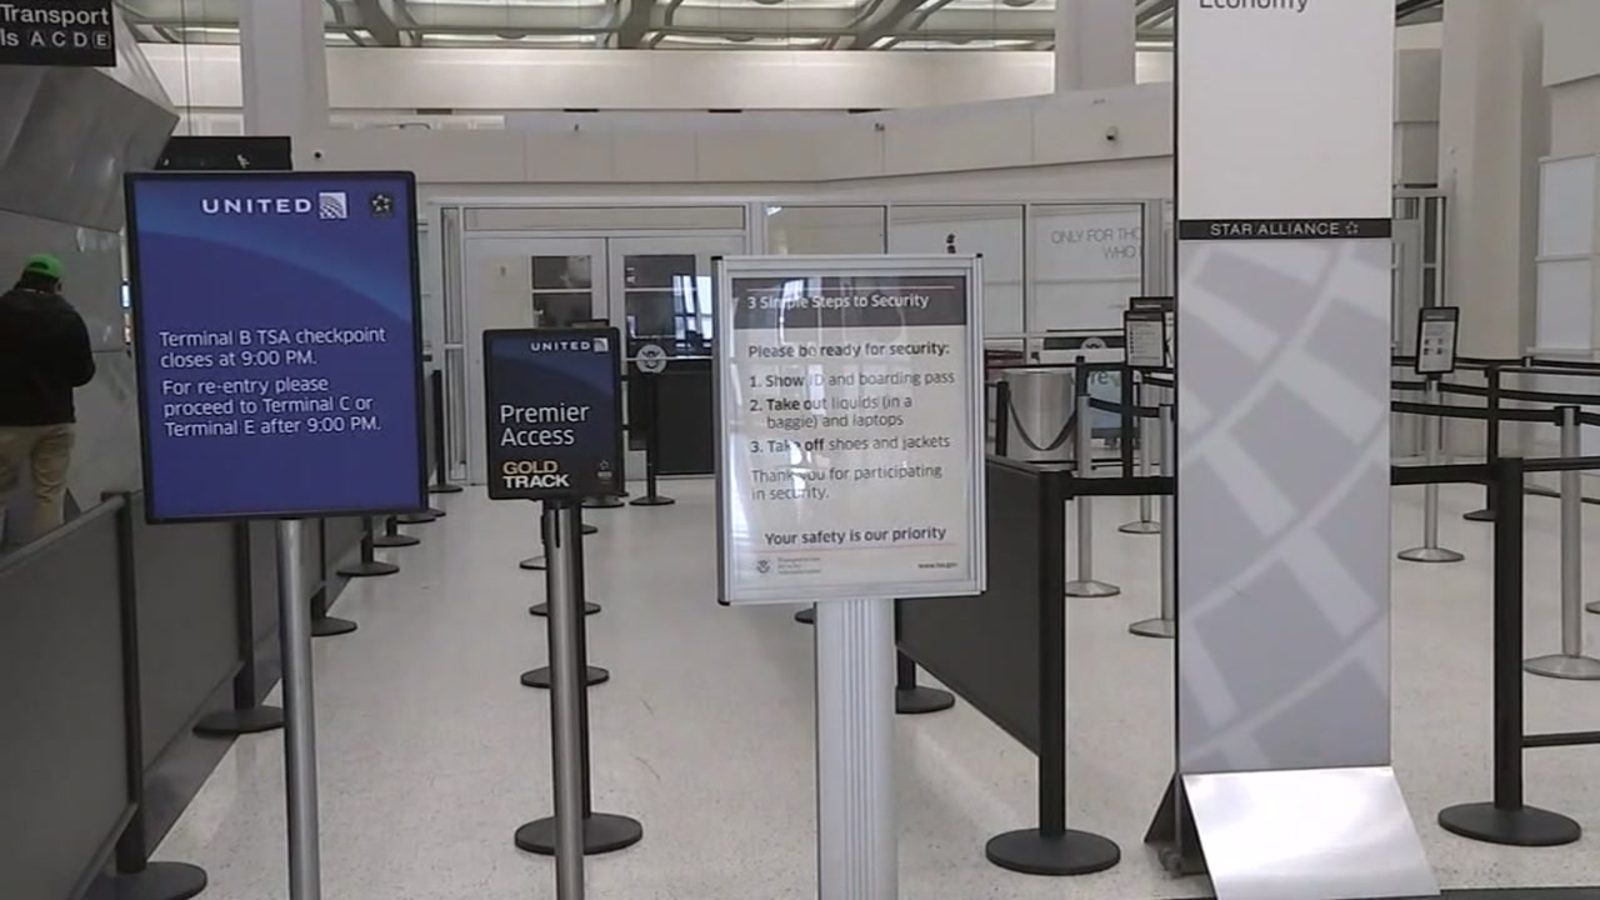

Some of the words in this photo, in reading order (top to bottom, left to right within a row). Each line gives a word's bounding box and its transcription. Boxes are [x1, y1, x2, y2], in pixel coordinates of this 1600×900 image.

[0, 4, 110, 27] Transport
[30, 31, 46, 47] A
[52, 31, 66, 47] C
[74, 32, 88, 47] D
[96, 34, 107, 46] E
[202, 198, 312, 214] UNITED
[1051, 230, 1084, 244] ONLY
[1087, 228, 1113, 243] FOR
[1210, 222, 1252, 236] STAR
[1259, 221, 1340, 236] ALLIANCE
[748, 296, 757, 310] 3
[812, 293, 850, 311] Steps
[853, 295, 868, 308] to
[871, 292, 929, 309] Security
[160, 330, 233, 347] Terminal
[240, 330, 251, 345] B
[258, 329, 291, 345] TSA
[296, 327, 386, 346] checkpoint
[531, 341, 591, 352] UNITED
[748, 345, 795, 359] Please
[820, 343, 862, 358] ready
[866, 342, 885, 356] for
[889, 342, 950, 358] security:
[160, 352, 213, 368] closes
[219, 353, 235, 366] at
[241, 350, 280, 366] 9:00
[286, 350, 317, 365] PM.
[163, 380, 192, 395] For
[198, 379, 269, 396] re-entry
[275, 377, 329, 394] please
[750, 375, 762, 388] 1.
[765, 374, 805, 388] Show
[810, 373, 825, 387] ID
[828, 373, 855, 387] and
[860, 371, 922, 387] boarding
[925, 372, 955, 385] pass
[164, 400, 234, 418] proceed
[240, 400, 257, 413] to
[262, 396, 334, 412] Terminal
[339, 397, 351, 411] C
[355, 398, 374, 411] or
[500, 402, 590, 424] Premier
[750, 399, 763, 412] 2.
[766, 398, 800, 411] Take
[803, 397, 827, 411] out
[903, 396, 912, 408] a
[164, 420, 239, 437] Terminal
[244, 420, 256, 435] E
[261, 418, 302, 434] after
[307, 417, 345, 432] 9:00
[351, 416, 381, 431] PM.
[766, 415, 818, 431] baggie)
[822, 414, 848, 428] and
[853, 413, 904, 428] laptops
[500, 428, 575, 446] Access
[750, 440, 763, 454] 3.
[804, 438, 825, 452] off
[828, 437, 869, 451] shoes
[873, 436, 898, 450] and
[902, 435, 951, 451] jackets
[503, 461, 558, 474] GOLD
[752, 469, 793, 483] Thank
[829, 467, 850, 481] for
[854, 465, 942, 481] participating
[503, 474, 570, 488] TRACK
[752, 488, 765, 500] in
[765, 532, 797, 546] Your
[801, 530, 845, 546] safety
[850, 531, 862, 542] is
[864, 529, 890, 542] our
[892, 527, 947, 544] priority
